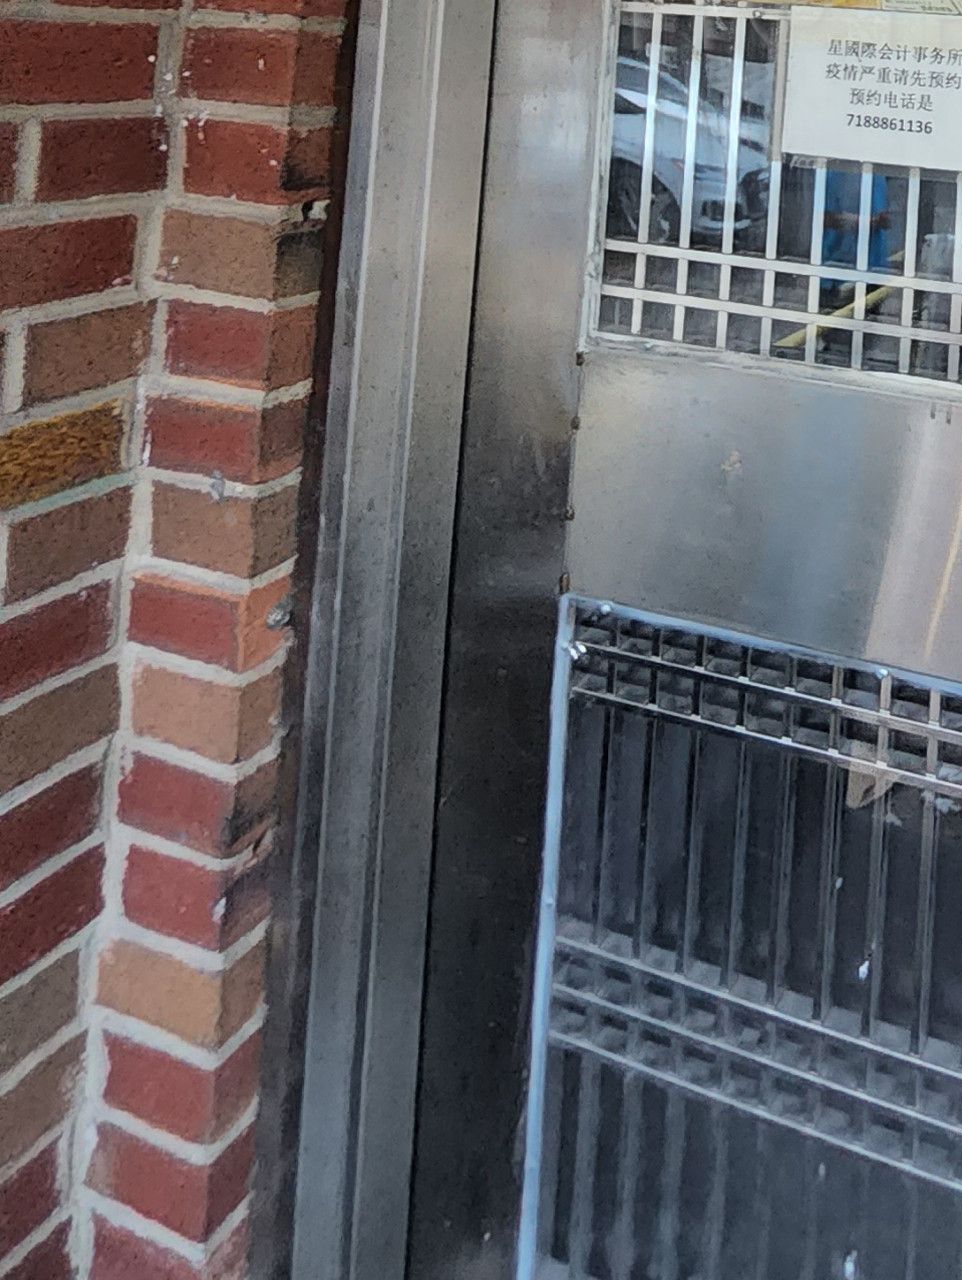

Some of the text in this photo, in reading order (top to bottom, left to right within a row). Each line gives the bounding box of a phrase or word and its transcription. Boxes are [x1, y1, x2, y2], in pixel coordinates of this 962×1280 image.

[825, 62, 962, 90] 疫情严重请先预约
[849, 87, 934, 112] 预约电话是
[845, 113, 933, 135] 7188861136
